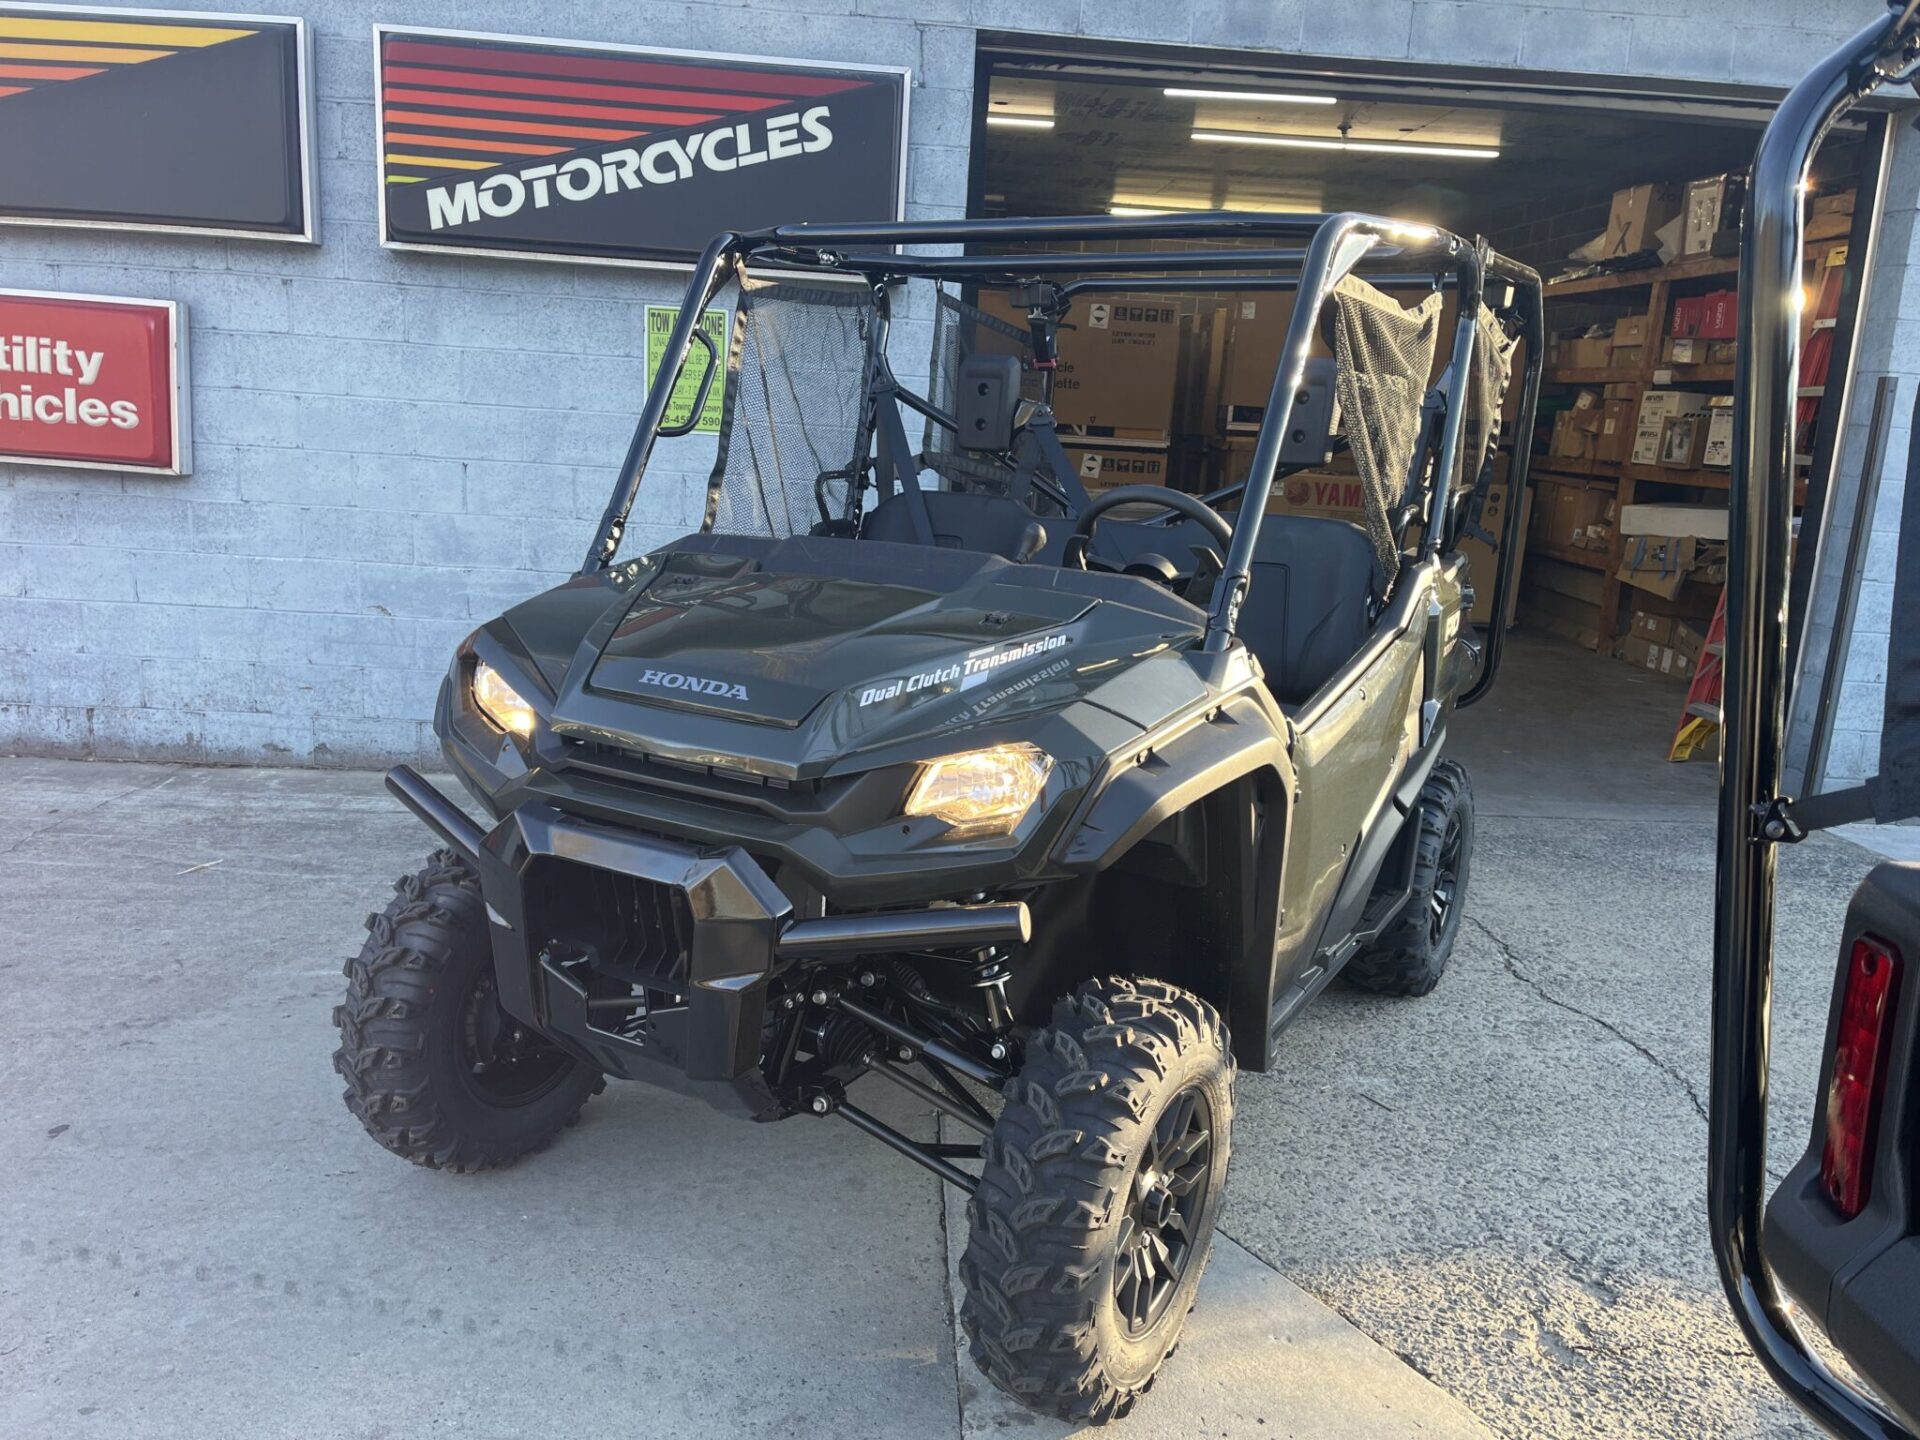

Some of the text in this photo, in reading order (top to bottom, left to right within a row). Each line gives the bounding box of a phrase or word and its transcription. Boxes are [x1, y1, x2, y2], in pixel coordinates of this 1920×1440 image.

[426, 105, 833, 230] MOTORCYCLES
[650, 311, 670, 333] TOW
[701, 314, 723, 336] ONE
[672, 401, 692, 413] Towing
[1314, 482, 1365, 508] YAM
[638, 669, 749, 701] HONDA
[859, 634, 1067, 707] Dual Clutch Transmission
